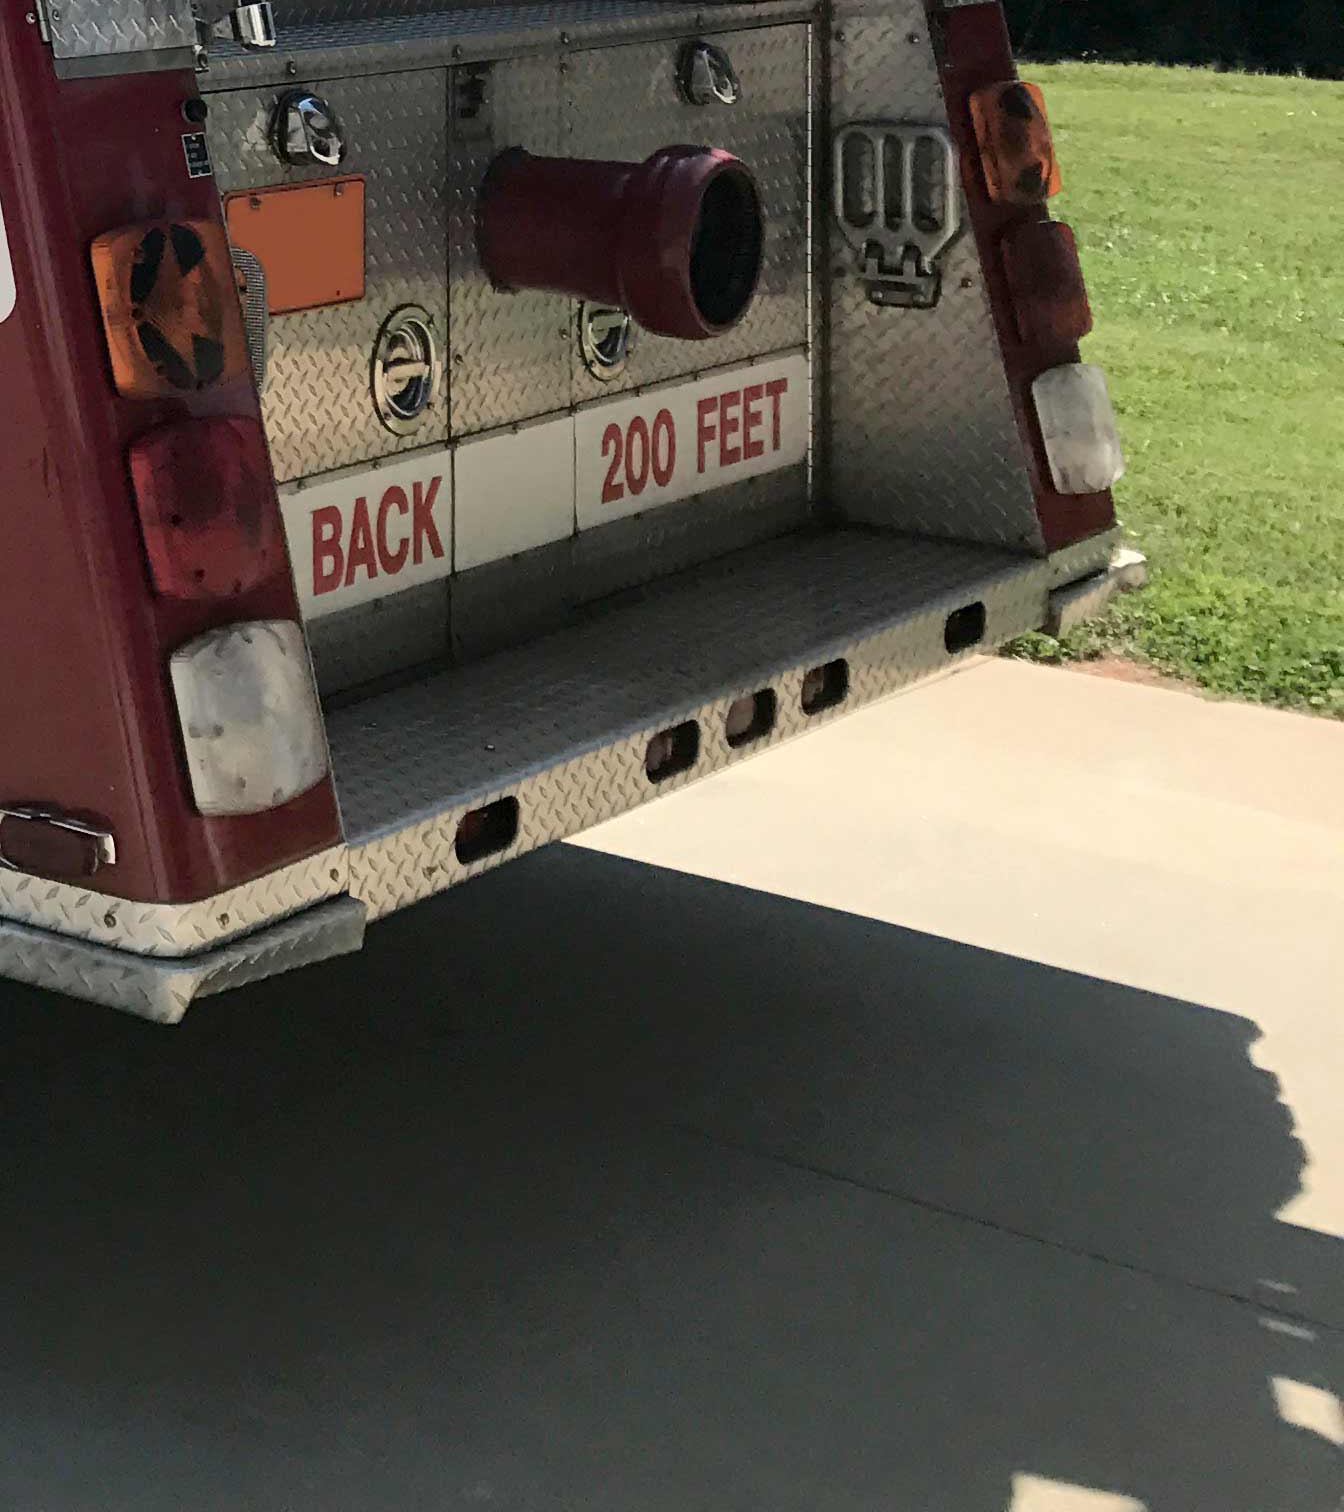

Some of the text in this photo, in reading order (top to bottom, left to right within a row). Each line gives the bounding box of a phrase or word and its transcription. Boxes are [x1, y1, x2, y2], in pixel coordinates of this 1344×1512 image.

[311, 378, 788, 596] BACK 200 FEET
